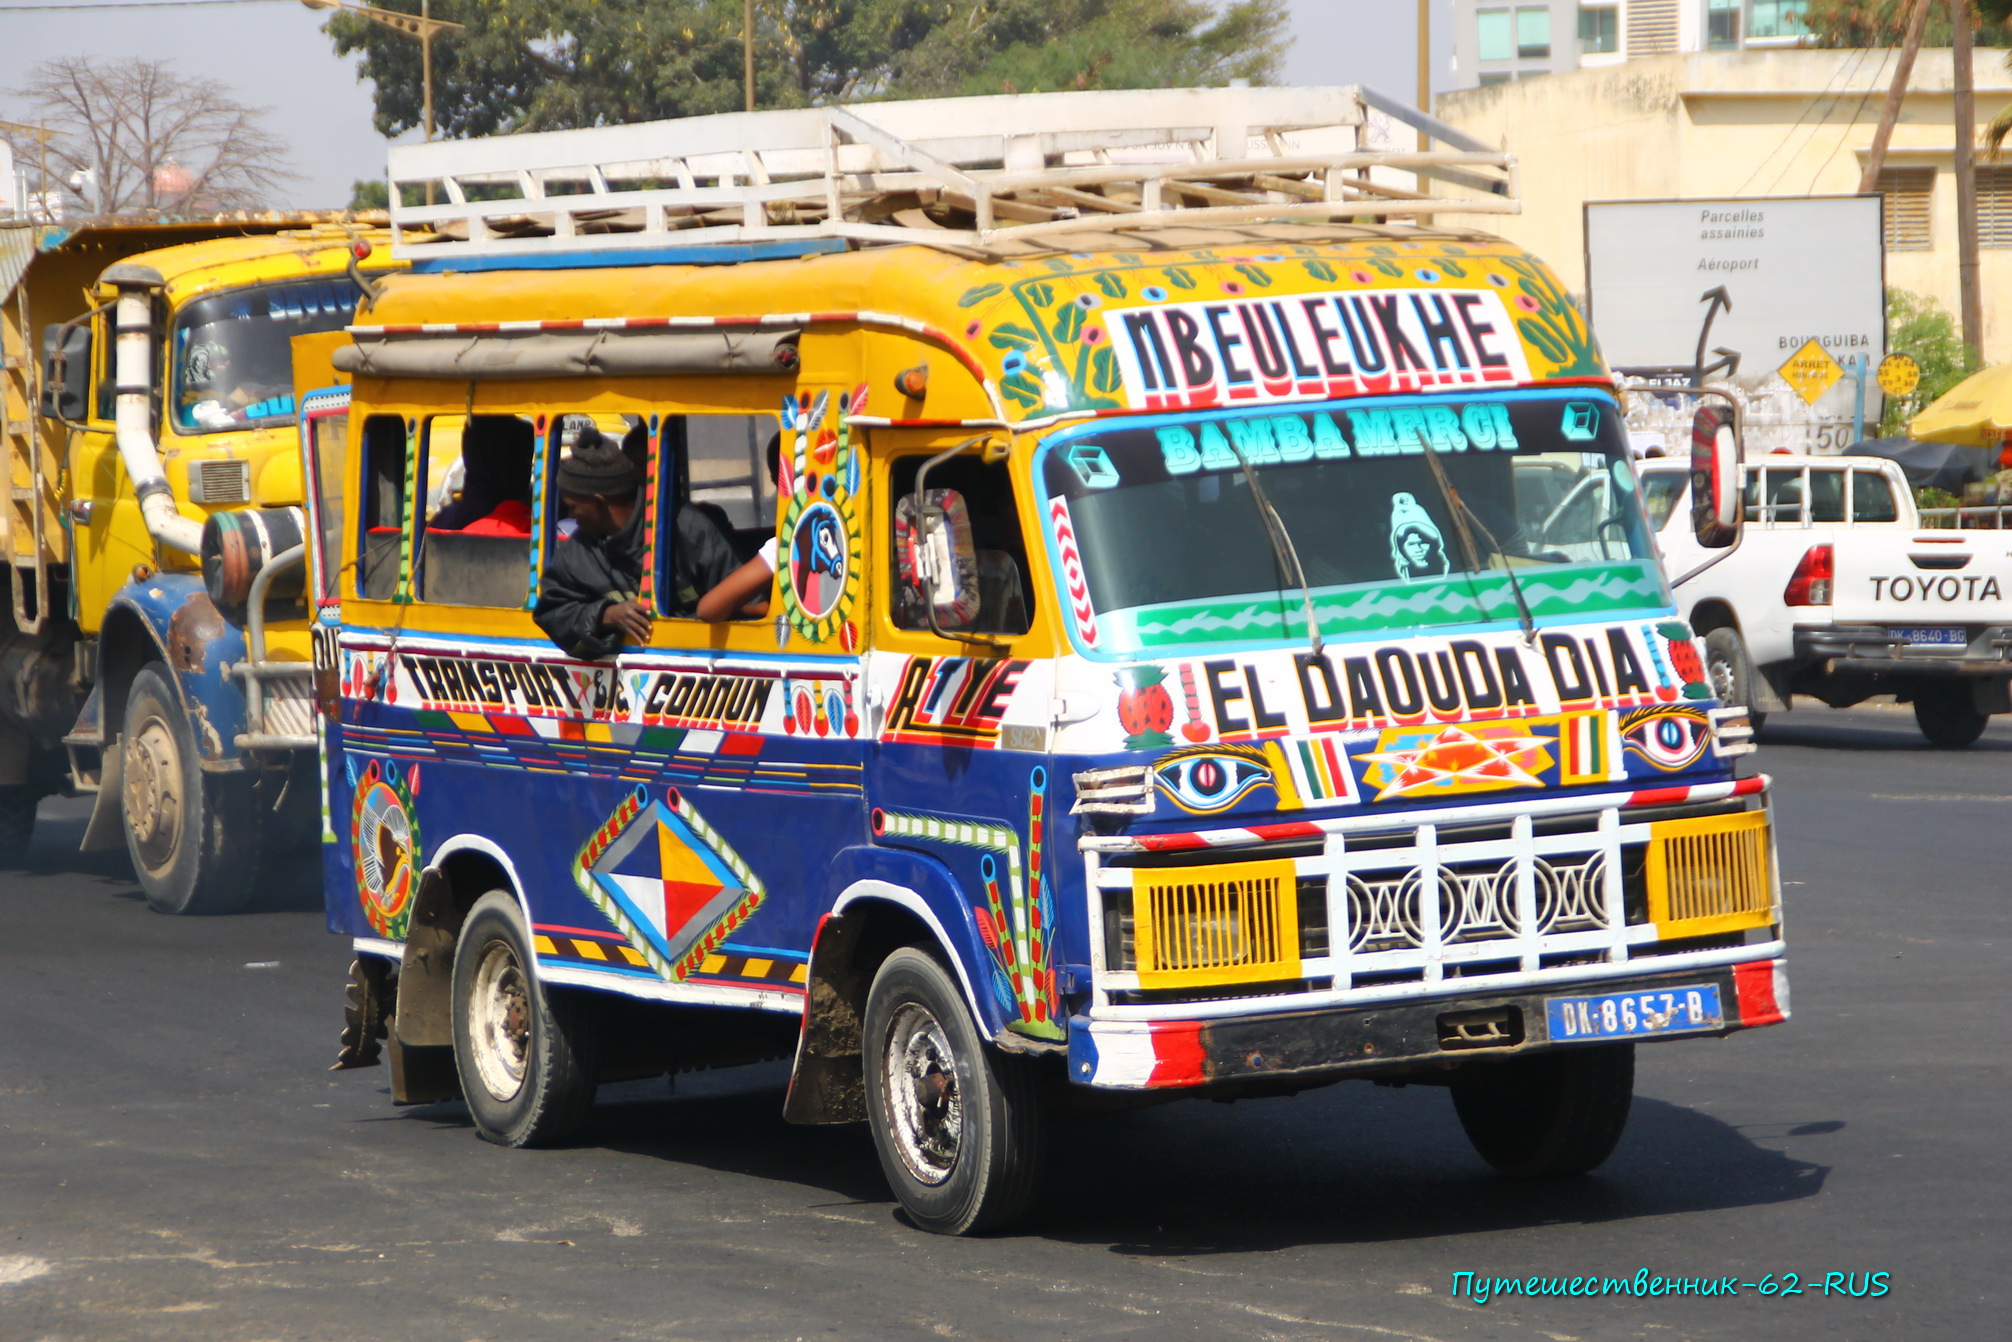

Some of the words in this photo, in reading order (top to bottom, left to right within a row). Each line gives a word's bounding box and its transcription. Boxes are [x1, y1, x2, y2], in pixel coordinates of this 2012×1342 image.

[1701, 209, 1765, 222] Parcelles
[1701, 225, 1765, 239] assainies
[1697, 257, 1759, 273] Aéroport
[1156, 413, 1351, 475] BAMBA
[1347, 403, 1519, 457] MERCI
[1817, 424, 1849, 449] 50
[1869, 575, 2003, 602] TOYOTA
[400, 655, 584, 712] TRANSPORT
[643, 672, 774, 724] COMMUN
[1204, 659, 1290, 738] EL
[1293, 640, 1535, 724] DAOUDA
[1539, 628, 1654, 708] DIA
